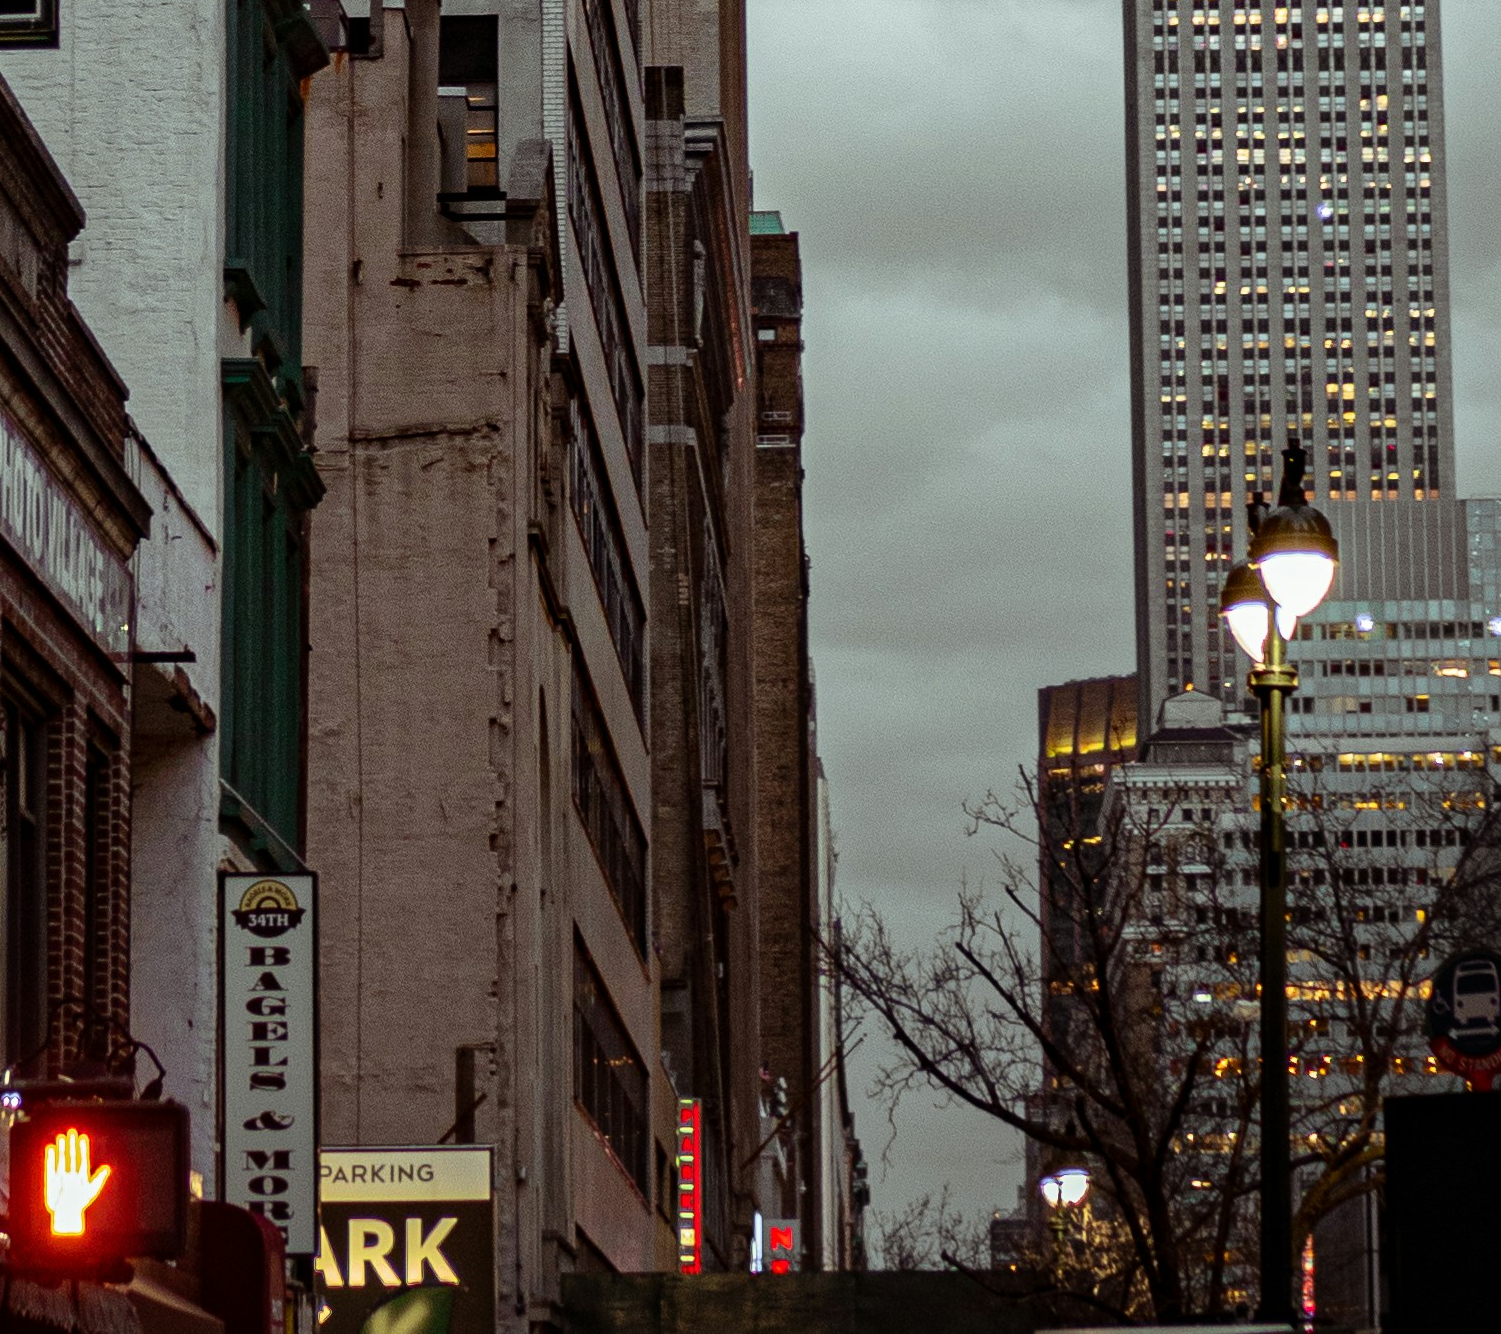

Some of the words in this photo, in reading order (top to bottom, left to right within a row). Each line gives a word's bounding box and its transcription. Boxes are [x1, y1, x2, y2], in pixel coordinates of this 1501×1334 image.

[248, 914, 289, 927] 34TH
[245, 946, 291, 1092] BAGELS
[243, 1110, 295, 1131] &
[318, 1163, 435, 1183] PARKING
[242, 1149, 296, 1248] MOR
[315, 1216, 461, 1288] ARK
